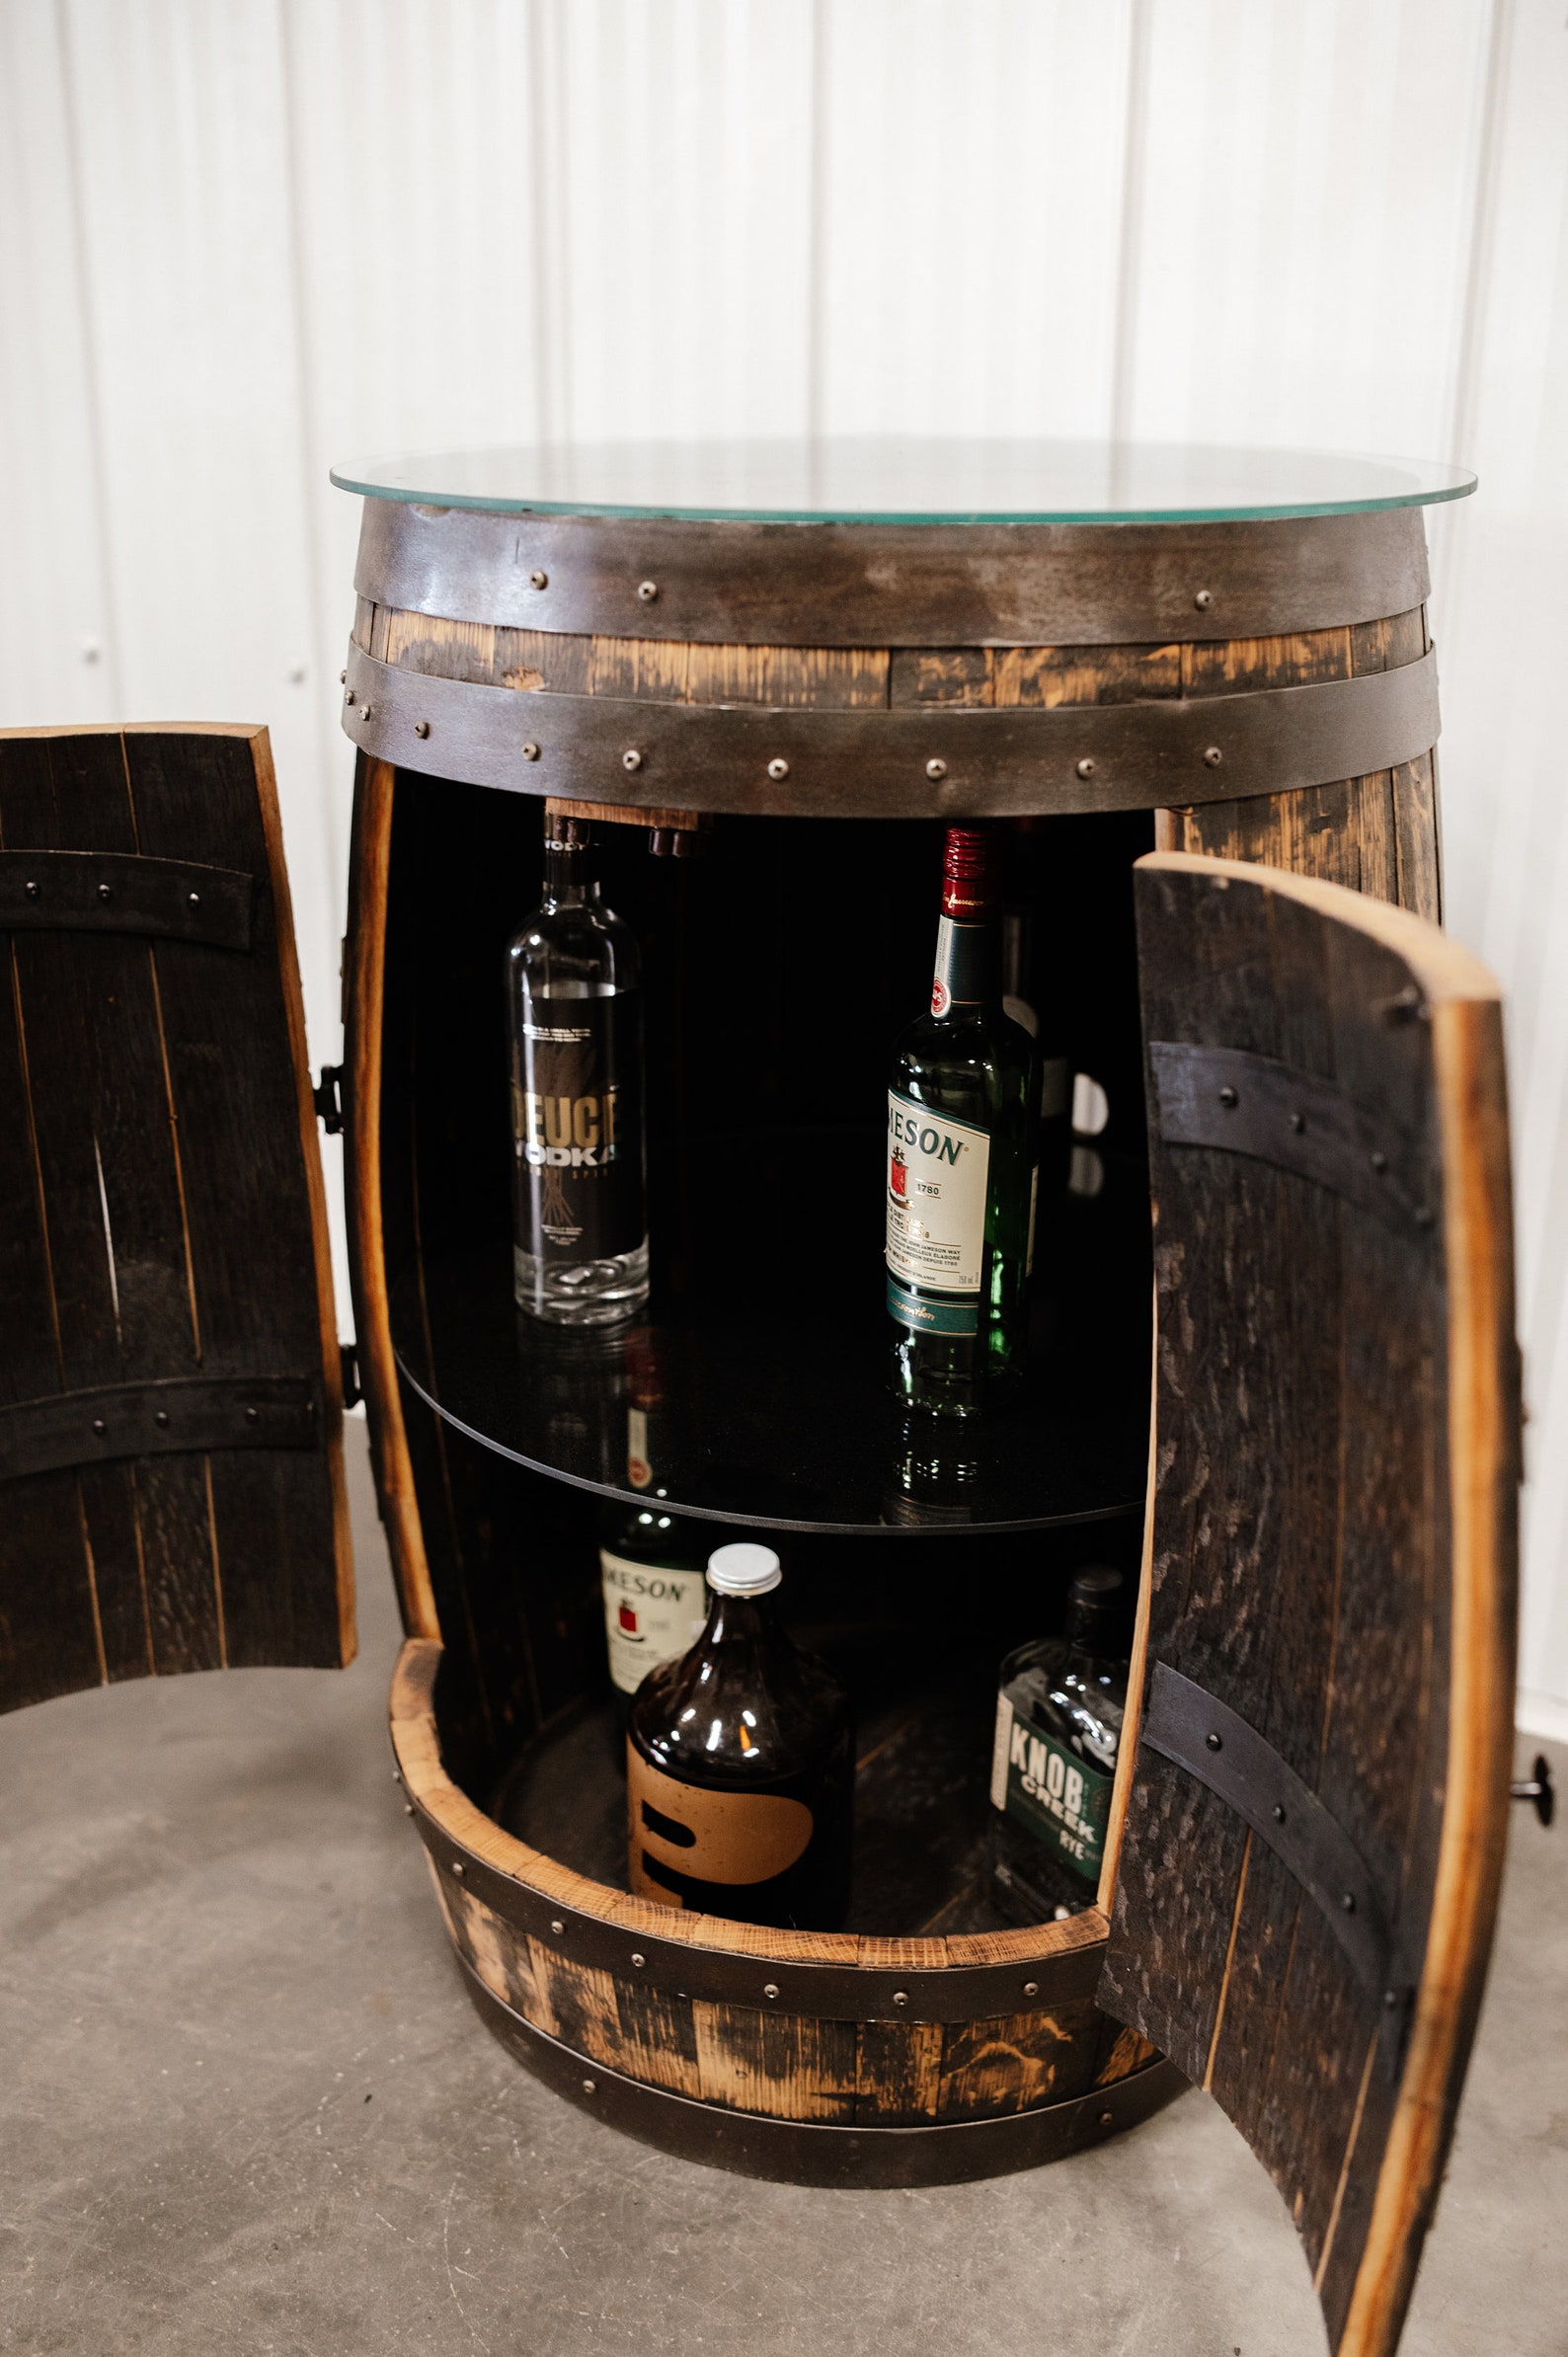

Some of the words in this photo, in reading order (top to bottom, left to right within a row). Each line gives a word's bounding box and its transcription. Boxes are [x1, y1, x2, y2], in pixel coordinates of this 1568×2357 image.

[890, 1107, 964, 1166] ESON
[917, 1183, 940, 1196] 1780
[921, 1244, 947, 1254] JAMESON
[1010, 1722, 1084, 1815] KNOB
[1021, 1774, 1099, 1845] CREEK
[1059, 1830, 1085, 1860] RYE
